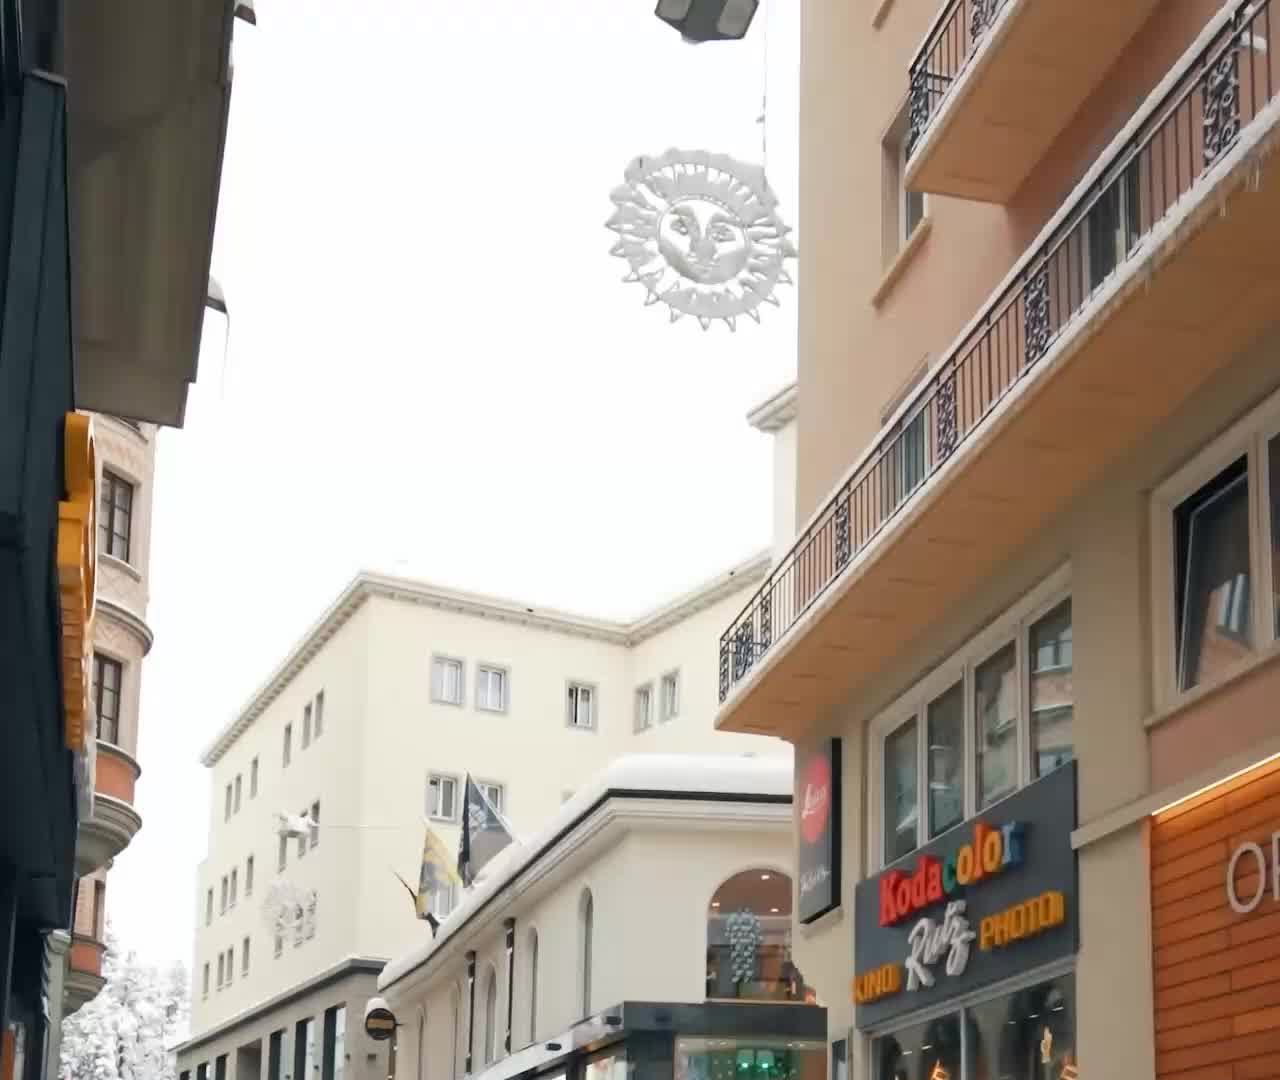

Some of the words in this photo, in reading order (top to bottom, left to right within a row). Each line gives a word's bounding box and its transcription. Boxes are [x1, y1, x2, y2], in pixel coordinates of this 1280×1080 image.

[878, 821, 1024, 928] Kodacolor
[905, 899, 977, 992] Rutz
[979, 889, 1065, 951] PHOTO
